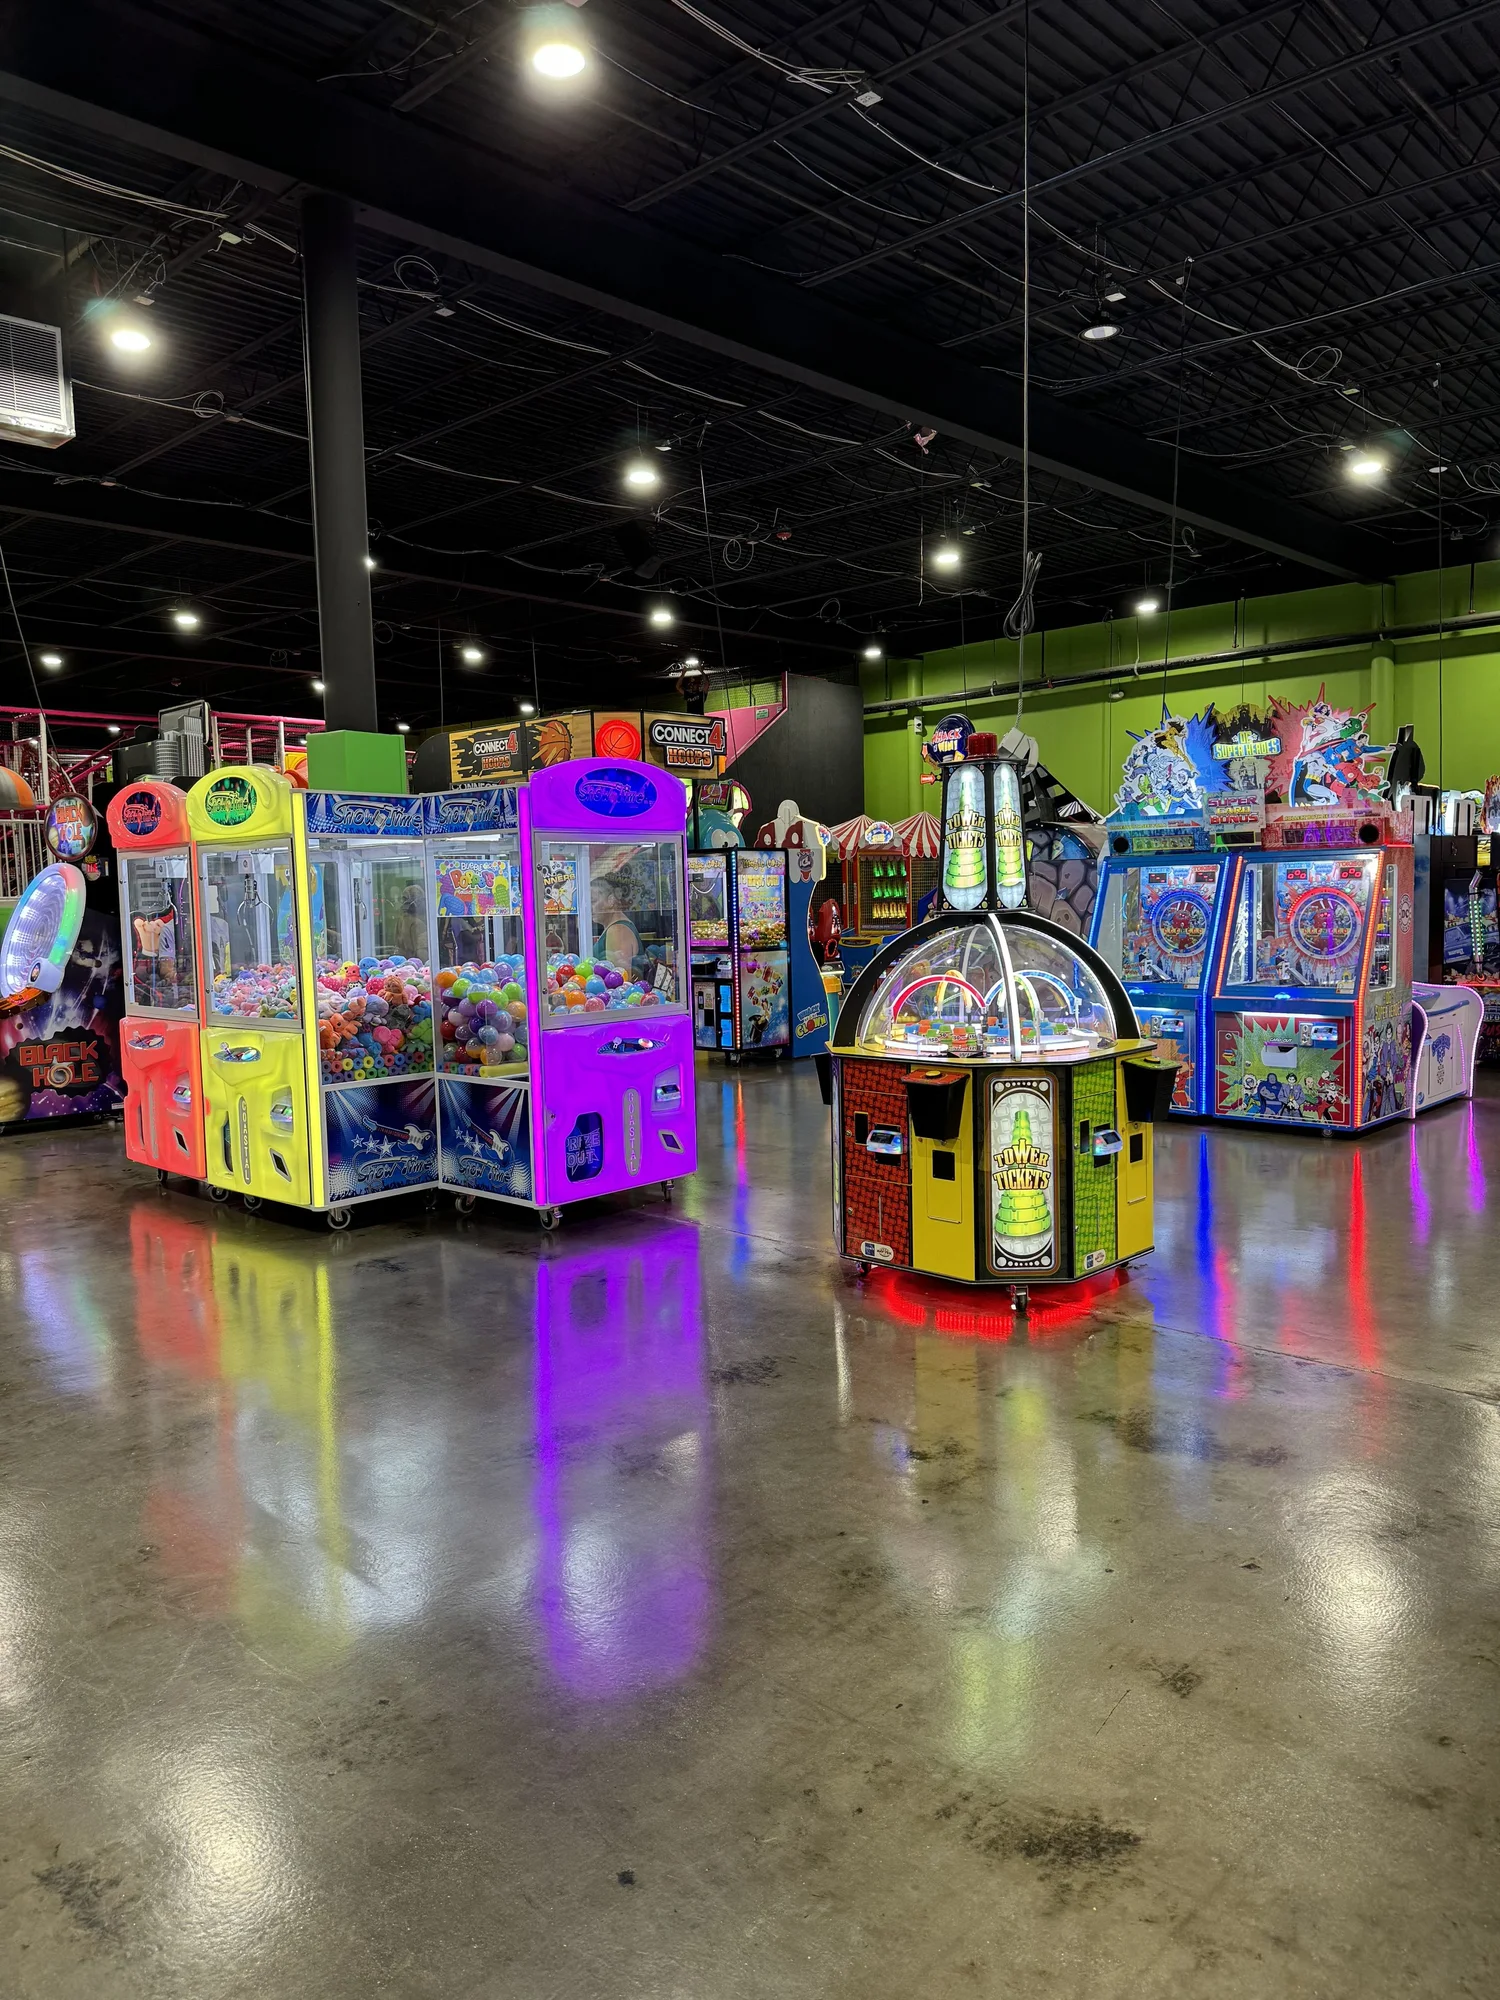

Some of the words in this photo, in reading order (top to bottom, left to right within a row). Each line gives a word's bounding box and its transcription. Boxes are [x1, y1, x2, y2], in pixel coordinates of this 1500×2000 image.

[474, 740, 509, 754] CONNECT
[507, 731, 518, 754] 4
[654, 725, 710, 744] CONNECT
[709, 723, 723, 750] 4
[1239, 731, 1252, 744] DC
[667, 747, 711, 766] HOOPS
[1215, 744, 1243, 758] SUPER
[1246, 739, 1279, 754] HEROES
[482, 755, 511, 770] HOOPS
[1208, 795, 1258, 807] SUPER
[1216, 806, 1251, 815] CARD
[332, 801, 379, 826] Show
[384, 804, 422, 828] Time
[946, 804, 986, 830] TOWER
[994, 803, 1021, 827] TOWER
[1209, 813, 1259, 824] BONUS
[945, 831, 986, 849] TICKETS
[994, 828, 1022, 847] TICKETS
[544, 873, 576, 885] NNERS
[20, 1040, 99, 1066] BLACK
[32, 1062, 99, 1088] HOLE
[567, 1149, 595, 1168] OUT
[993, 1138, 1050, 1168] TOWER
[993, 1168, 1051, 1190] TICKETS
